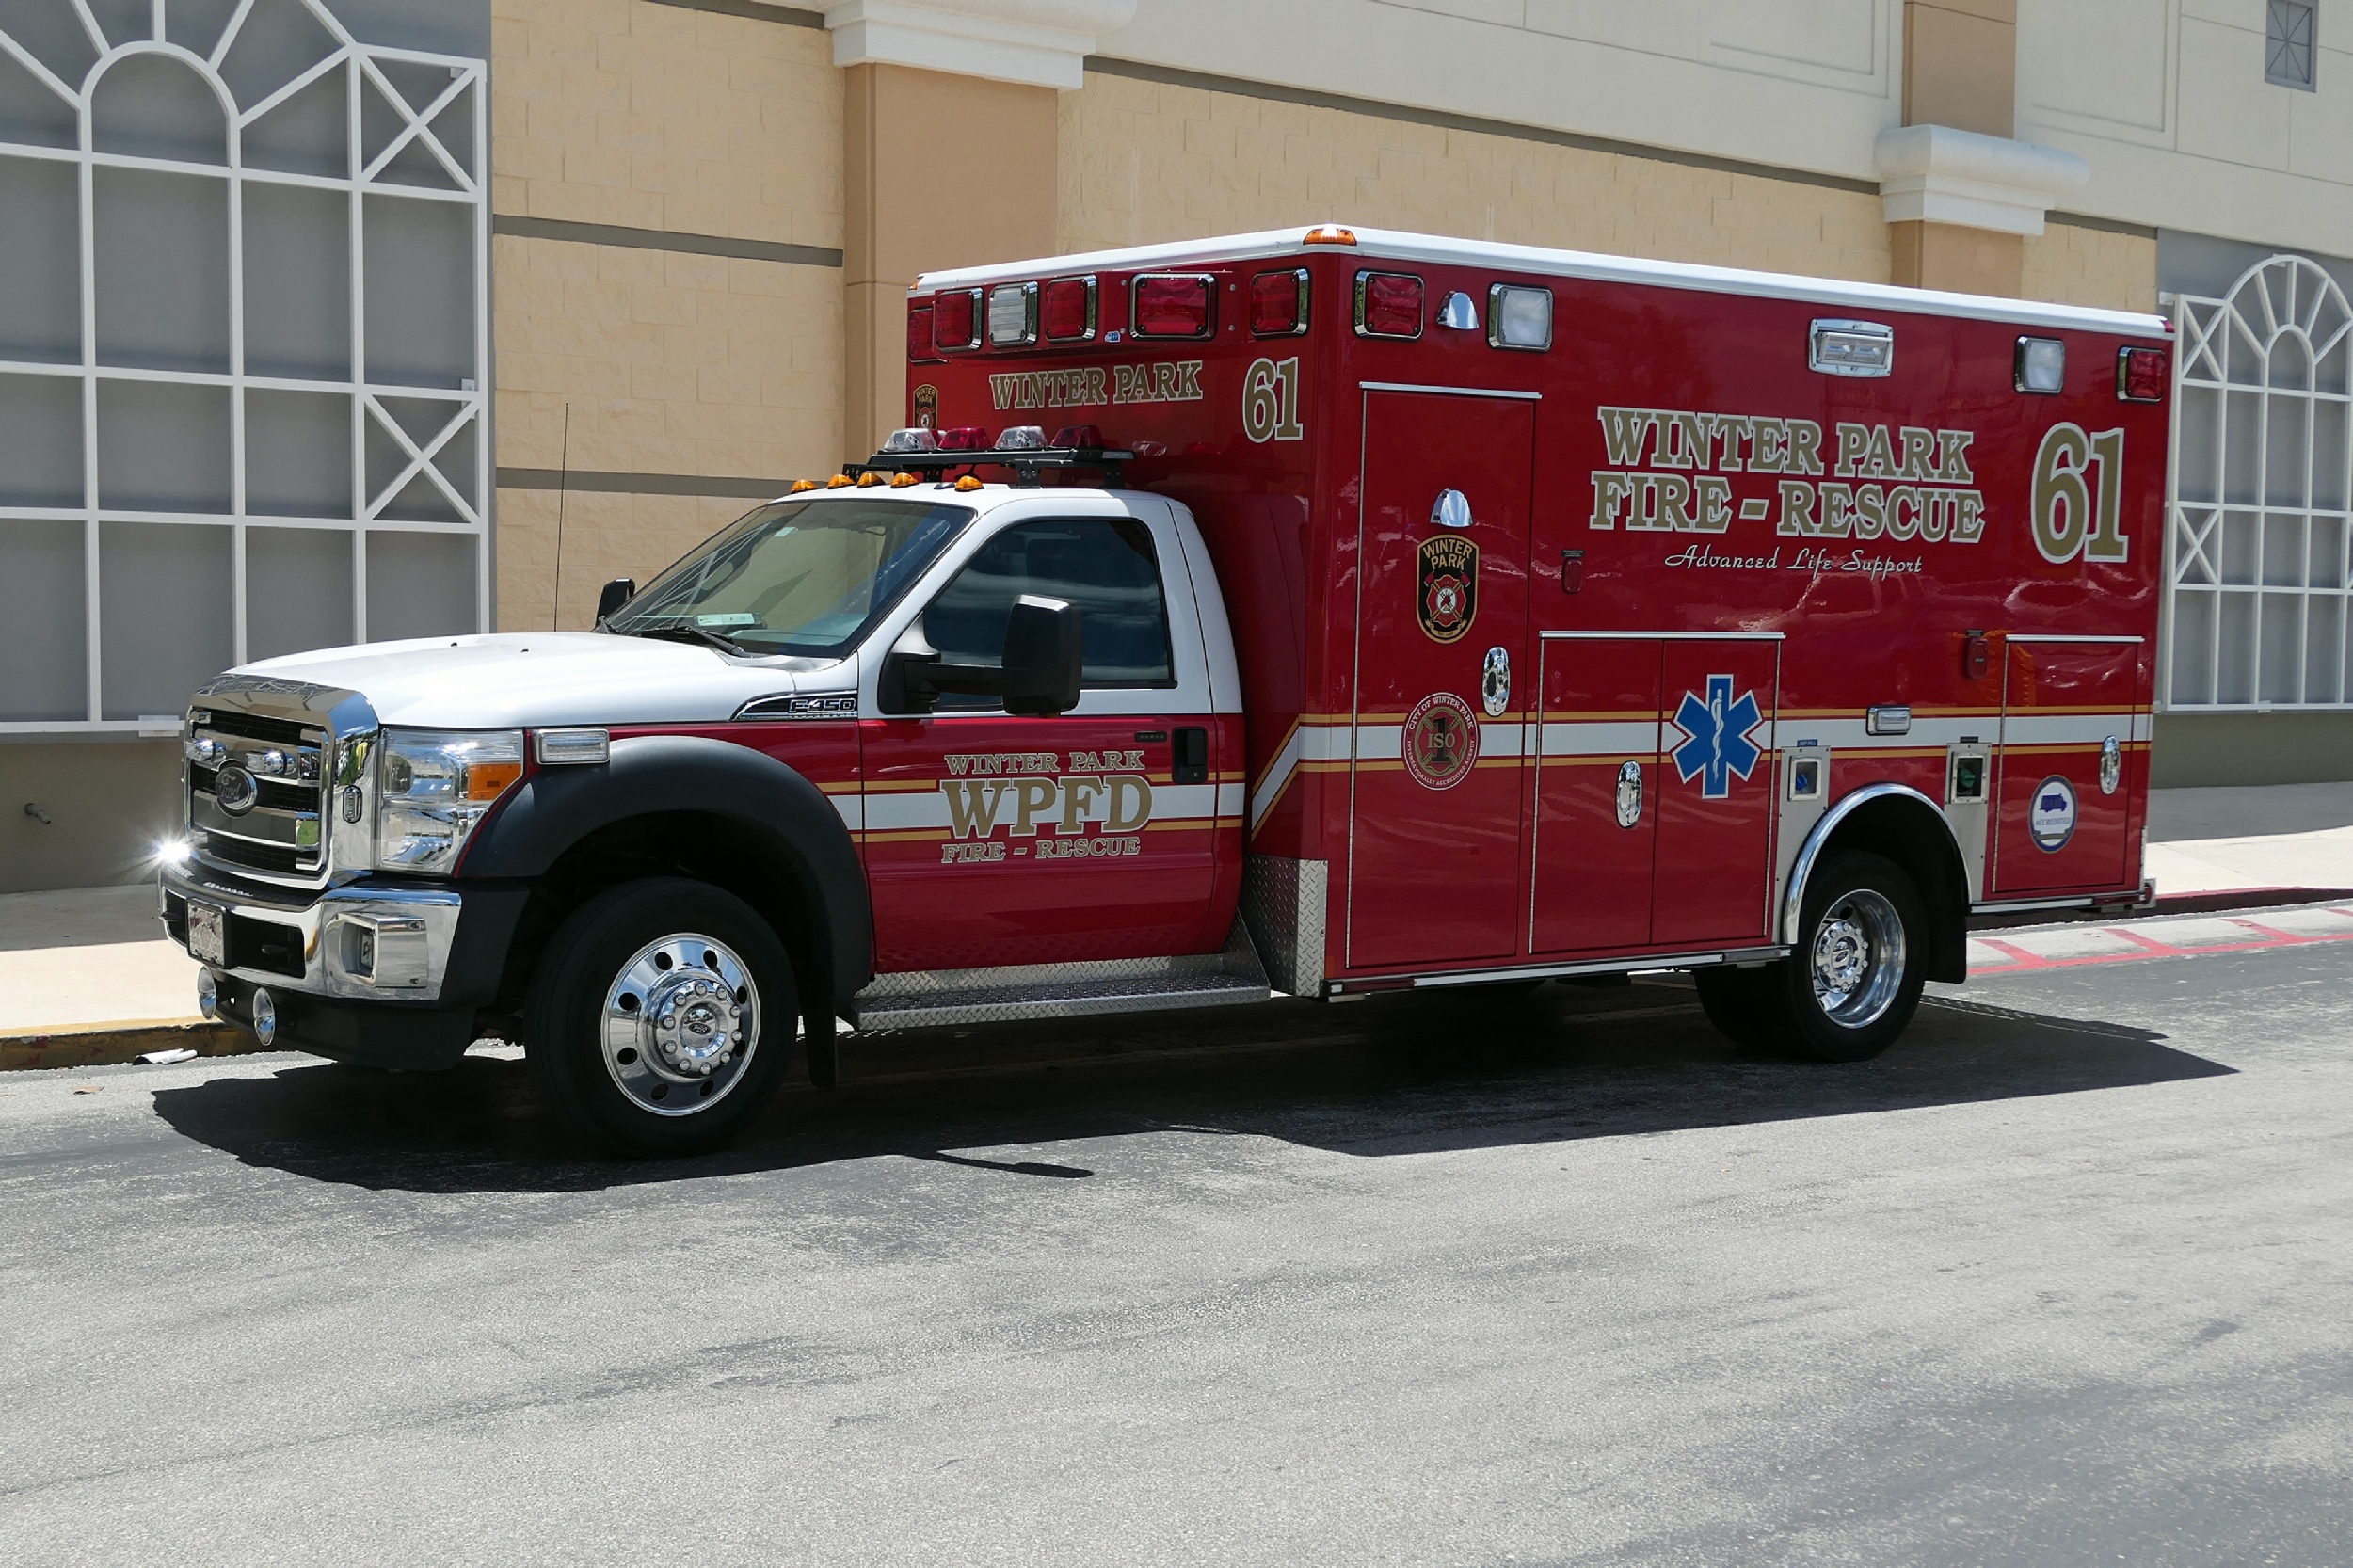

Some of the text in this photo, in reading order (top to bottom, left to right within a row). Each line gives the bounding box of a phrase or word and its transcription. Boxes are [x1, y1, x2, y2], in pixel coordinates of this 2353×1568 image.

[989, 360, 1203, 409] WINTER PARK
[1242, 356, 1303, 443] 61
[1597, 406, 1974, 484] WINTER PARK
[1589, 471, 1733, 533] FIRE
[1777, 480, 1985, 543] RESCUE
[2030, 422, 2129, 564] 61
[1423, 539, 1472, 558] WINTER
[1431, 553, 1465, 570] PARK
[1664, 543, 1923, 582] Advanced Life Support
[1409, 696, 1474, 729] CITY OF WINTER PARK
[1427, 732, 1456, 749] ISO
[944, 750, 1145, 775] WINTER PARK
[939, 775, 1153, 839] WPFD
[941, 842, 1006, 864] FIRE
[1035, 836, 1141, 859] RESCUE
